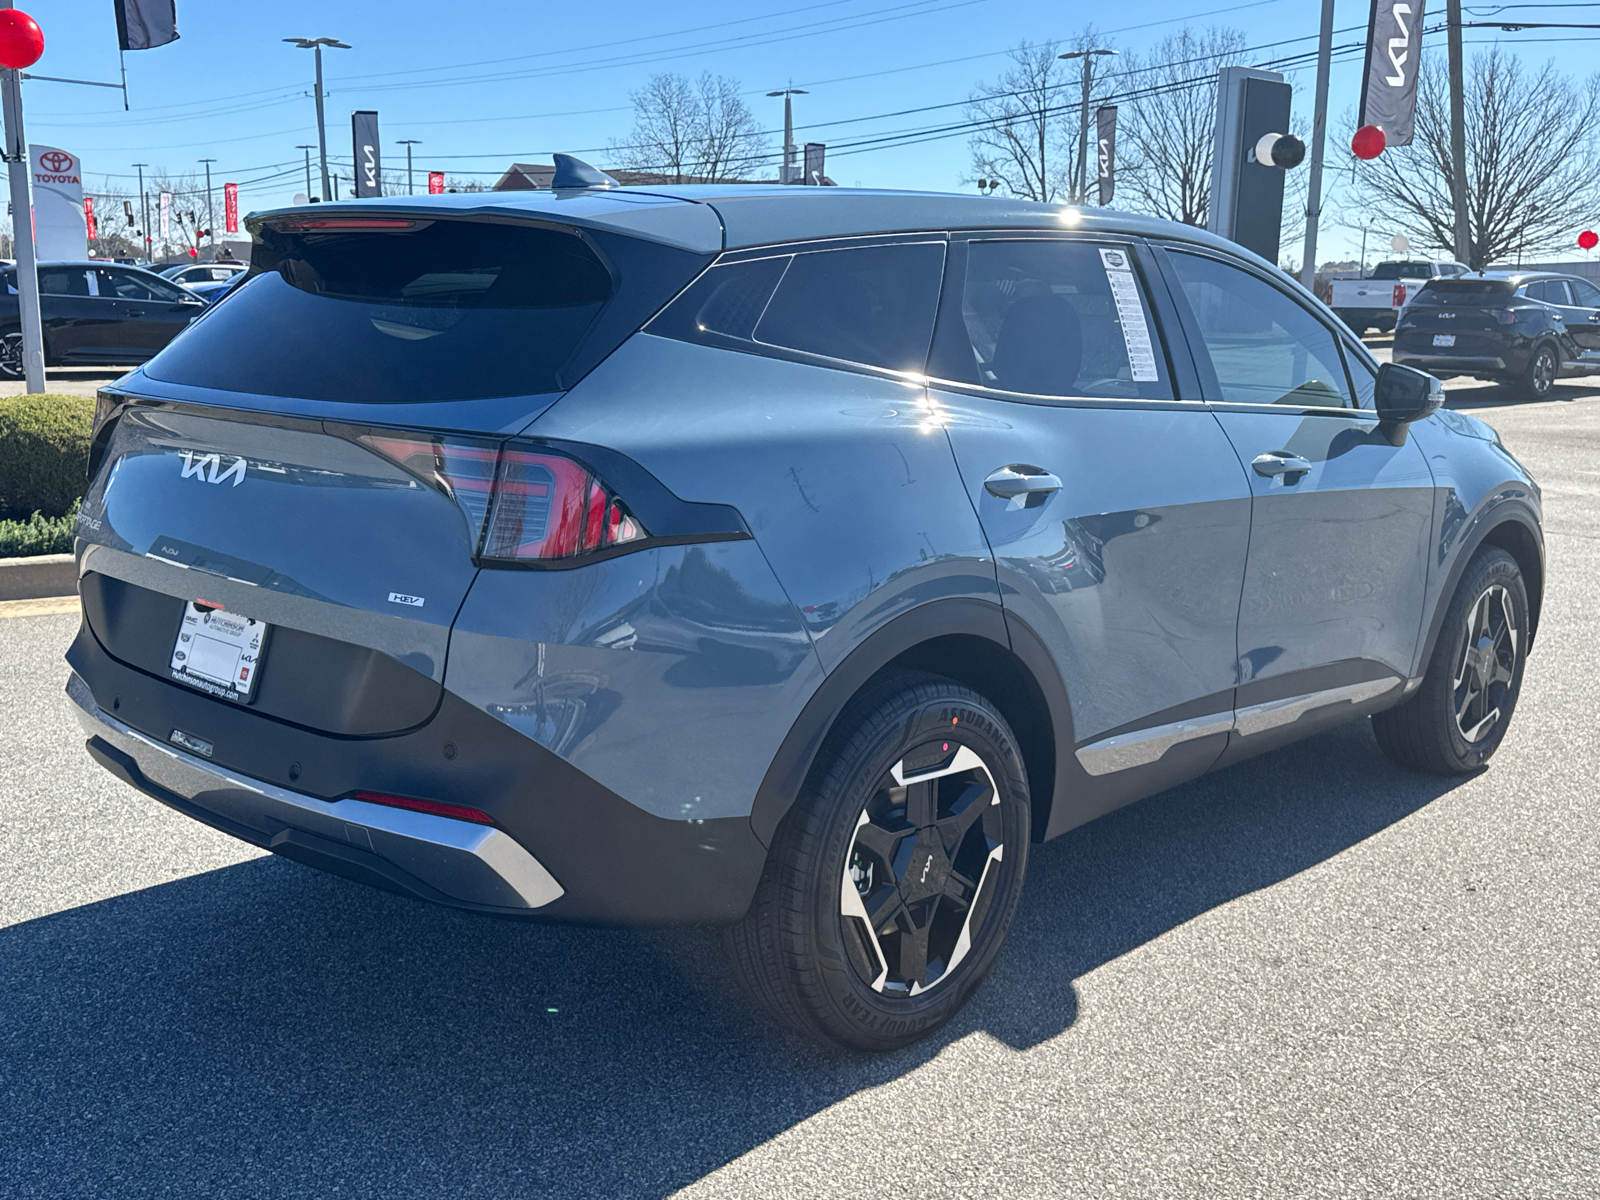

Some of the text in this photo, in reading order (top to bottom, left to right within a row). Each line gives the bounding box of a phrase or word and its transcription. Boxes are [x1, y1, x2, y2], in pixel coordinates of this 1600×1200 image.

[1385, 3, 1412, 87] KIA
[363, 145, 376, 187] KIA
[1099, 139, 1109, 178] KIA
[35, 174, 80, 184] TOYOTA
[180, 450, 247, 488] KIA
[394, 594, 420, 604] HEV
[939, 707, 1013, 759] ASSURANCE
